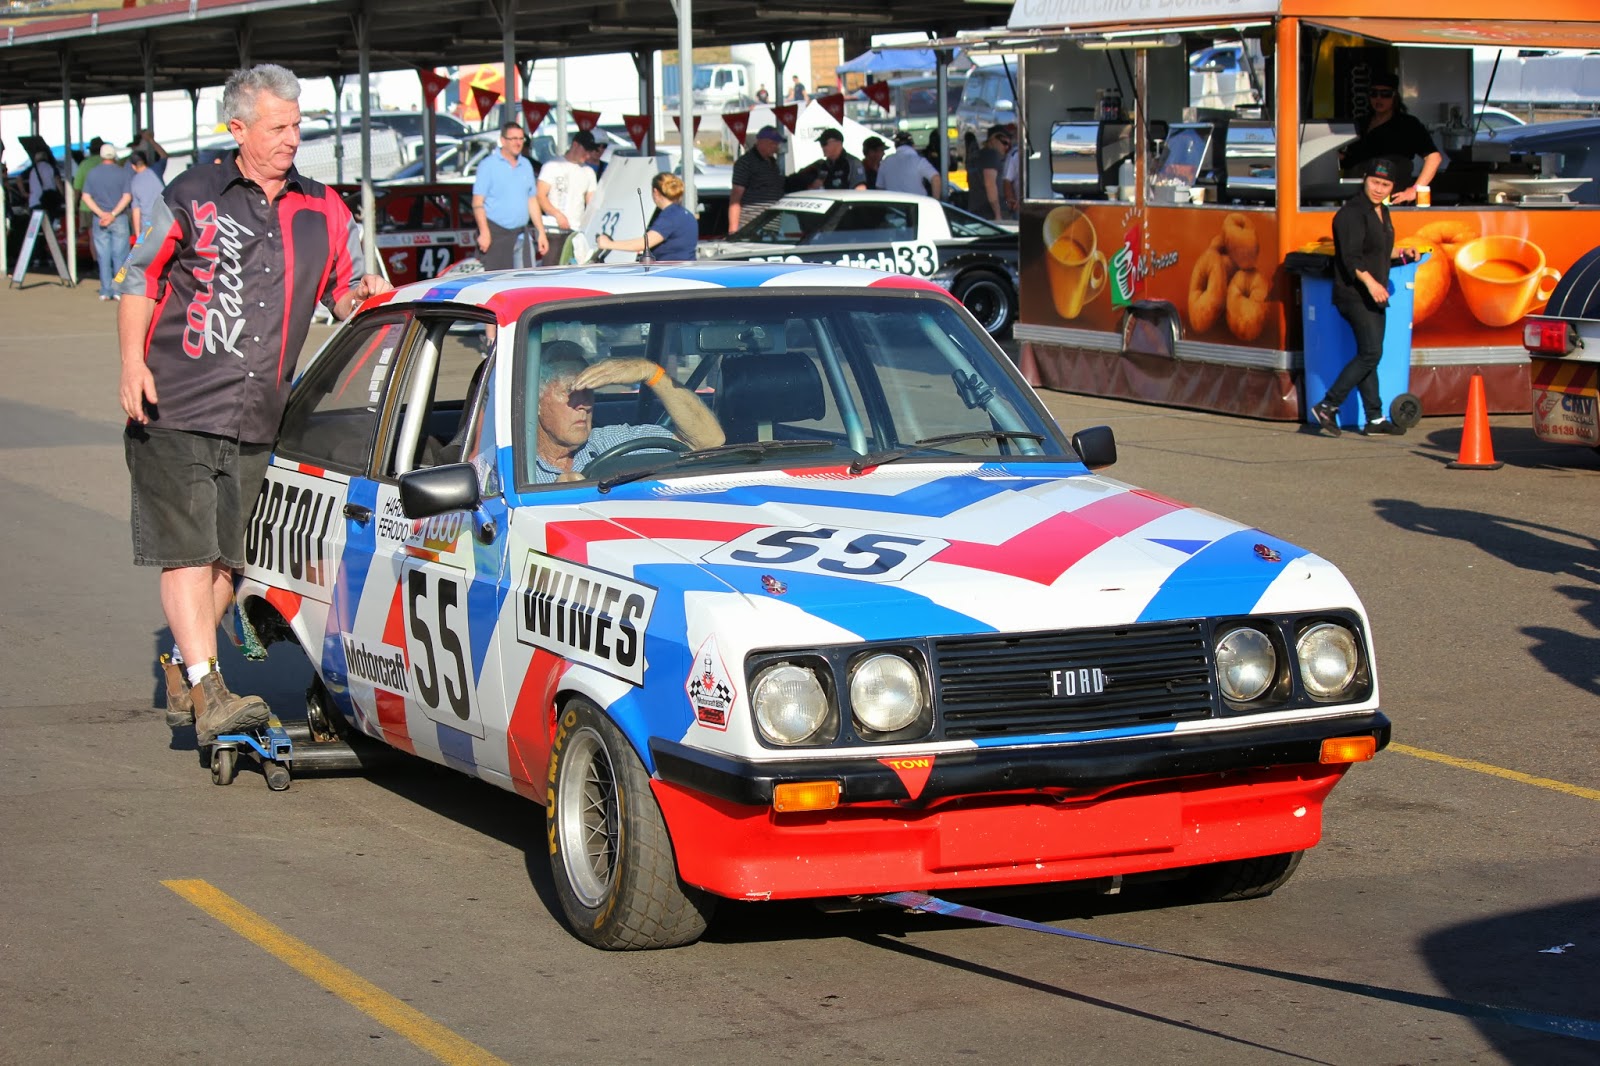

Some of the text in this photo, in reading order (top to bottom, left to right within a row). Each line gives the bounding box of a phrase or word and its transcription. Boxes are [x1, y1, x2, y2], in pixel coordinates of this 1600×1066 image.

[183, 200, 220, 359] COLLINS
[204, 213, 255, 359] Racing
[420, 247, 451, 279] 42
[898, 245, 936, 277] 33
[245, 477, 336, 588] ORTOLI
[377, 517, 409, 543] FERODO
[730, 528, 926, 576] 55
[523, 563, 646, 668] WINES
[345, 640, 409, 693] Motorcraft
[408, 569, 471, 721] 55
[1052, 668, 1104, 697] FORD
[547, 710, 577, 855] KUMHO
[890, 758, 929, 770] TOW
